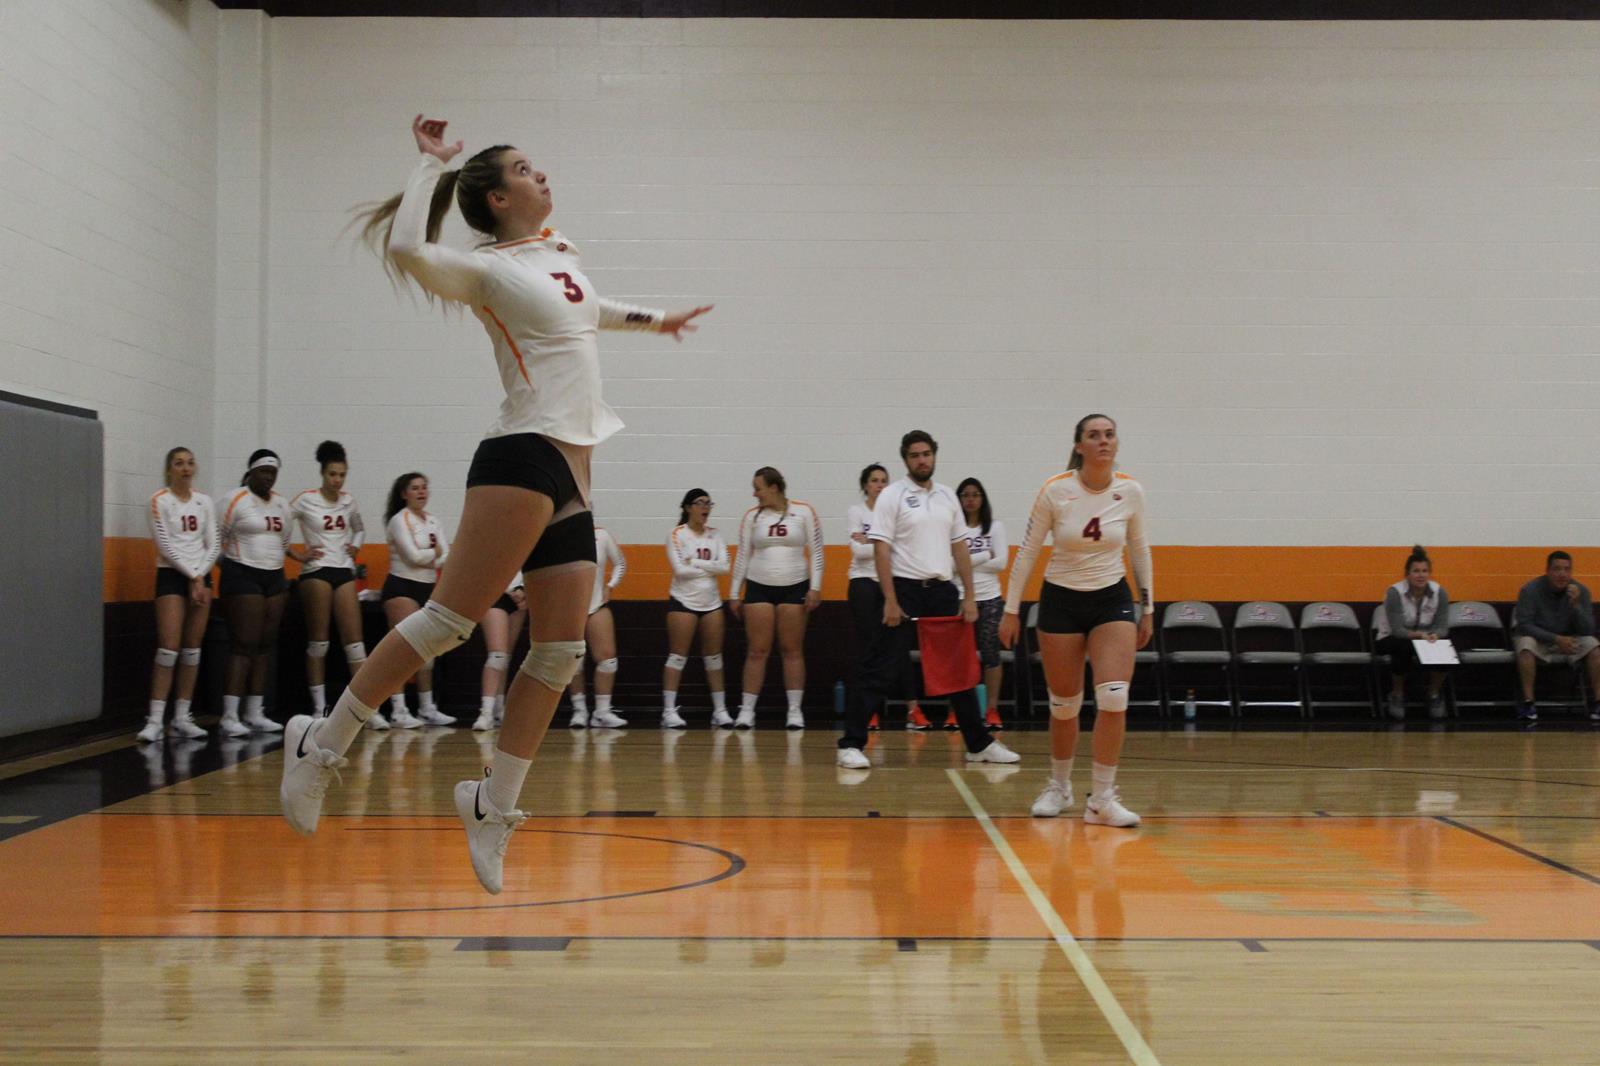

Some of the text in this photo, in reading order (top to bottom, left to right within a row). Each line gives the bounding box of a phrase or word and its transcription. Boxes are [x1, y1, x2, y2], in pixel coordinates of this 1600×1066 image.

[550, 272, 584, 304] 3
[181, 515, 198, 532] 18
[264, 516, 282, 532] 15
[323, 515, 346, 530] 24
[1082, 517, 1102, 541] 4
[768, 524, 788, 537] 16
[965, 535, 992, 548] OST
[696, 547, 711, 560] 10
